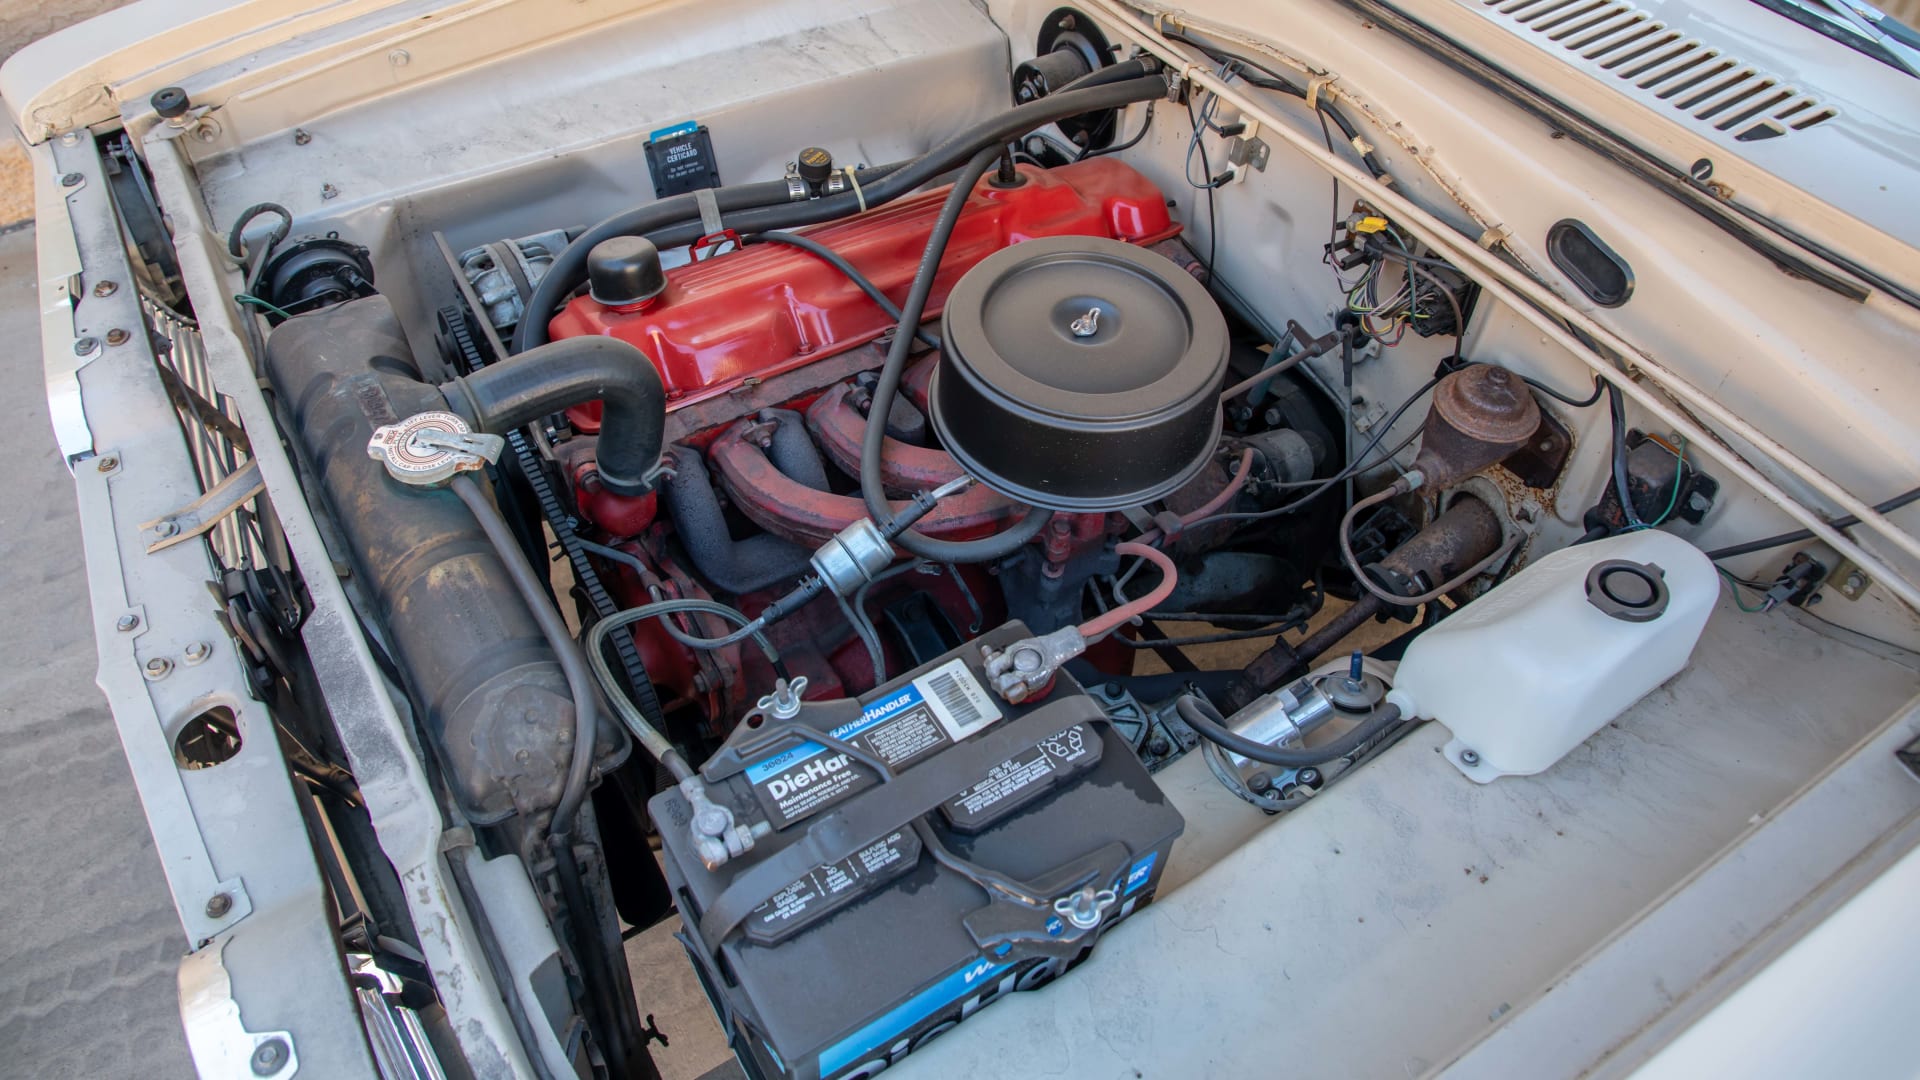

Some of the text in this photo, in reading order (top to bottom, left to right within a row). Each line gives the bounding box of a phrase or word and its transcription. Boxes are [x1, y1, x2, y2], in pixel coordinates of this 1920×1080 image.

[665, 147, 698, 163] CERTICARD
[668, 141, 693, 155] VEHICLE
[829, 693, 912, 738] EATHERHANDLER
[760, 751, 794, 772] 30024
[972, 761, 1022, 792] MEDICAL HELP FAST
[778, 767, 852, 809] Maintenance Free
[857, 831, 902, 859] SULFURIC ACID
[825, 865, 838, 876] NO
[772, 880, 807, 903] EXPLOSIVE
[775, 892, 799, 909] GASES
